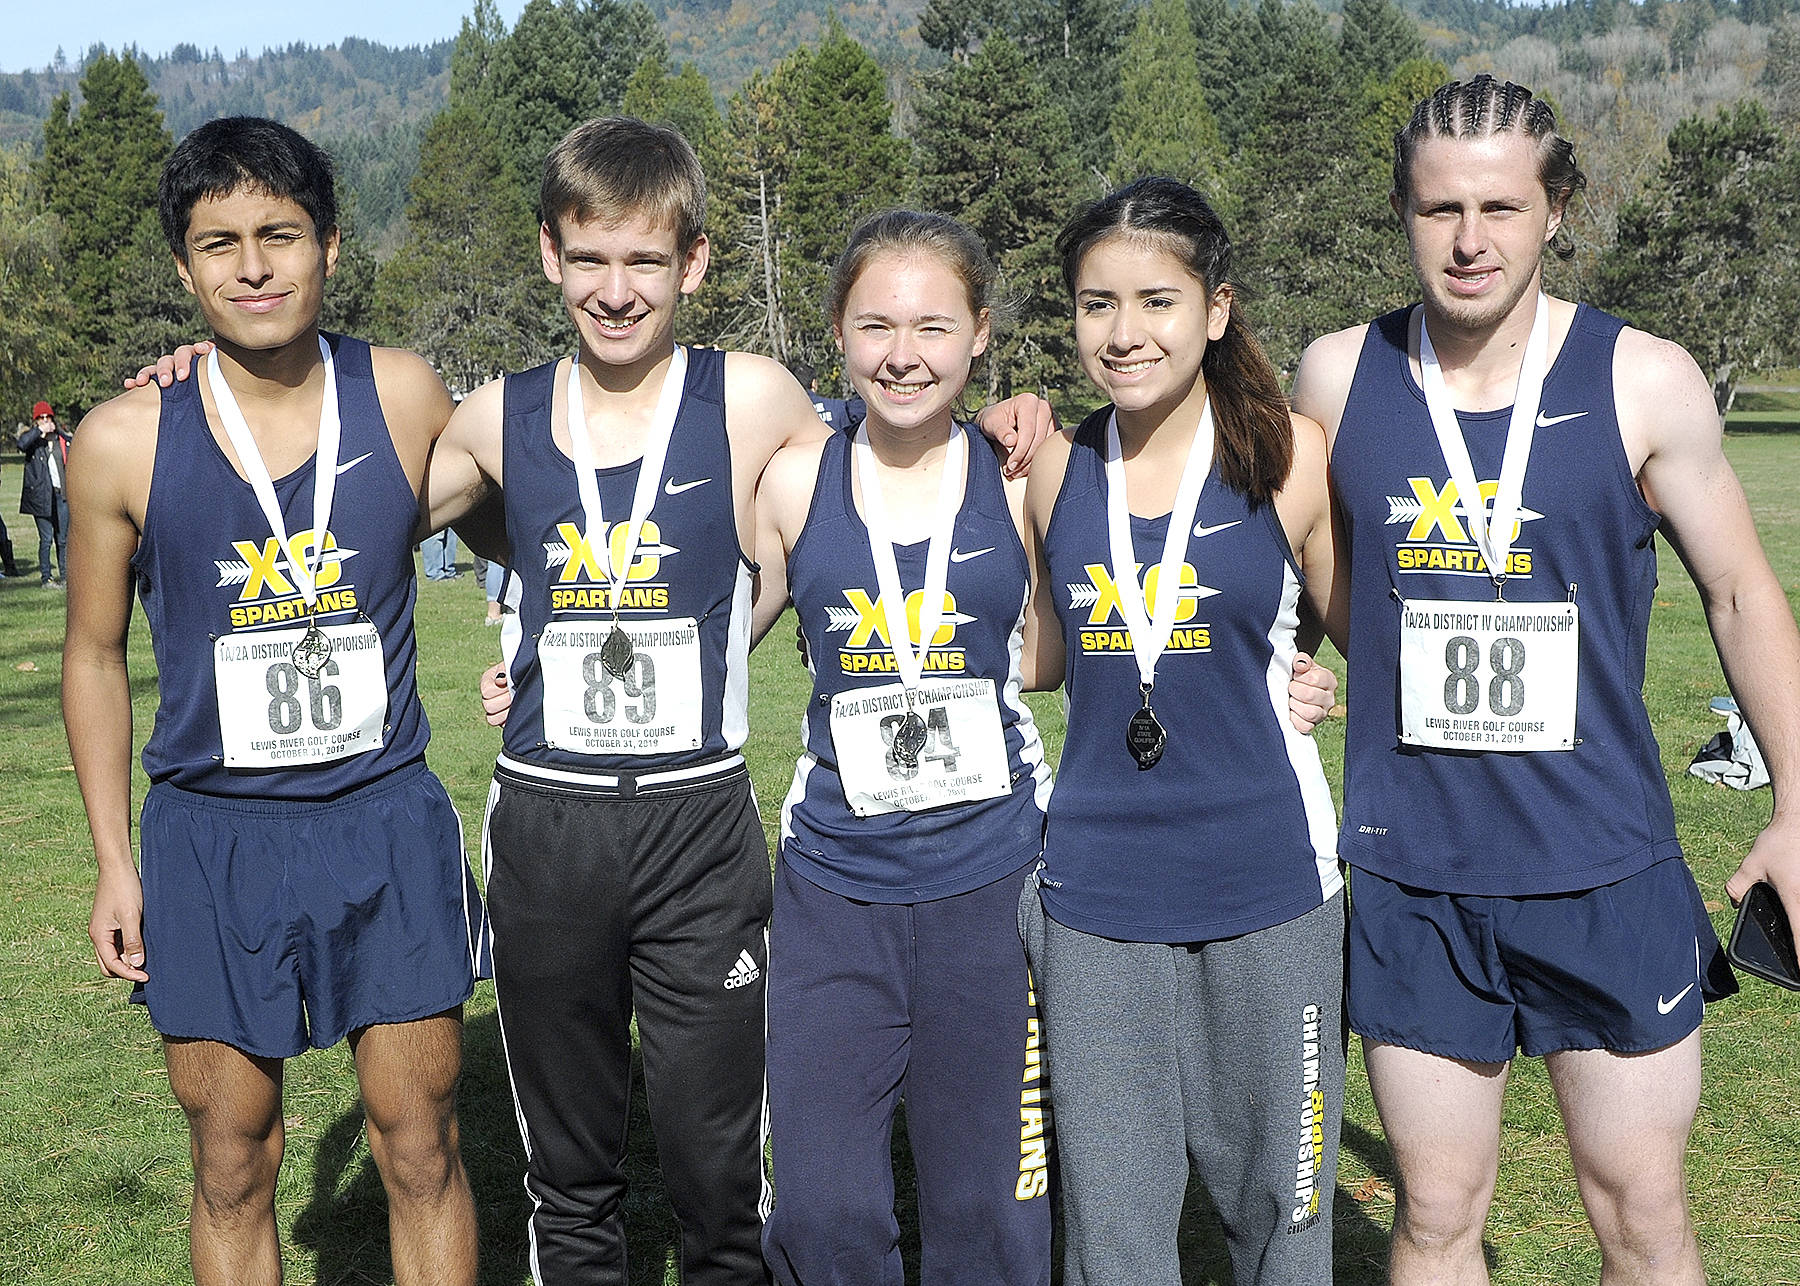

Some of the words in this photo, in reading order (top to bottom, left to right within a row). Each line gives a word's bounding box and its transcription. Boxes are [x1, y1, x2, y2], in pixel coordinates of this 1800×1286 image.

[1405, 612, 1431, 629] 1A/2A
[1433, 613, 1478, 631] DISTRICT
[1482, 614, 1492, 631] IV
[1495, 615, 1574, 632] CHAMPIONSHIP
[251, 641, 293, 660] DISTRICT
[330, 633, 377, 653] MPIONSHIP
[627, 629, 695, 648] HAMPIONSHIP
[1080, 629, 1211, 650] SPANS
[839, 651, 965, 672] SPARNS
[1443, 635, 1526, 717] 88
[265, 658, 343, 735] 86
[582, 652, 657, 724] 89
[862, 693, 904, 714] DISTRICT
[569, 726, 591, 737] LEWIS
[594, 728, 618, 738] RIVER
[620, 728, 641, 738] GOLF
[643, 725, 675, 738] COURSE
[1425, 717, 1450, 730] LEWIS
[1453, 719, 1480, 731] RIVER
[1482, 720, 1505, 732] GOLF
[1508, 721, 1545, 732] COURSE
[251, 740, 277, 751] LEWIS
[280, 737, 305, 749] RIVER
[307, 735, 329, 746] GOLF
[331, 730, 361, 744] COURSE
[585, 739, 621, 748] OCTOBER
[1443, 731, 1482, 742] OCTOBER
[1501, 734, 1524, 743] 2019
[270, 748, 308, 760] OCTOBER
[326, 744, 345, 755] 2019
[873, 788, 899, 801] LEWIS
[723, 968, 760, 990] adidas
